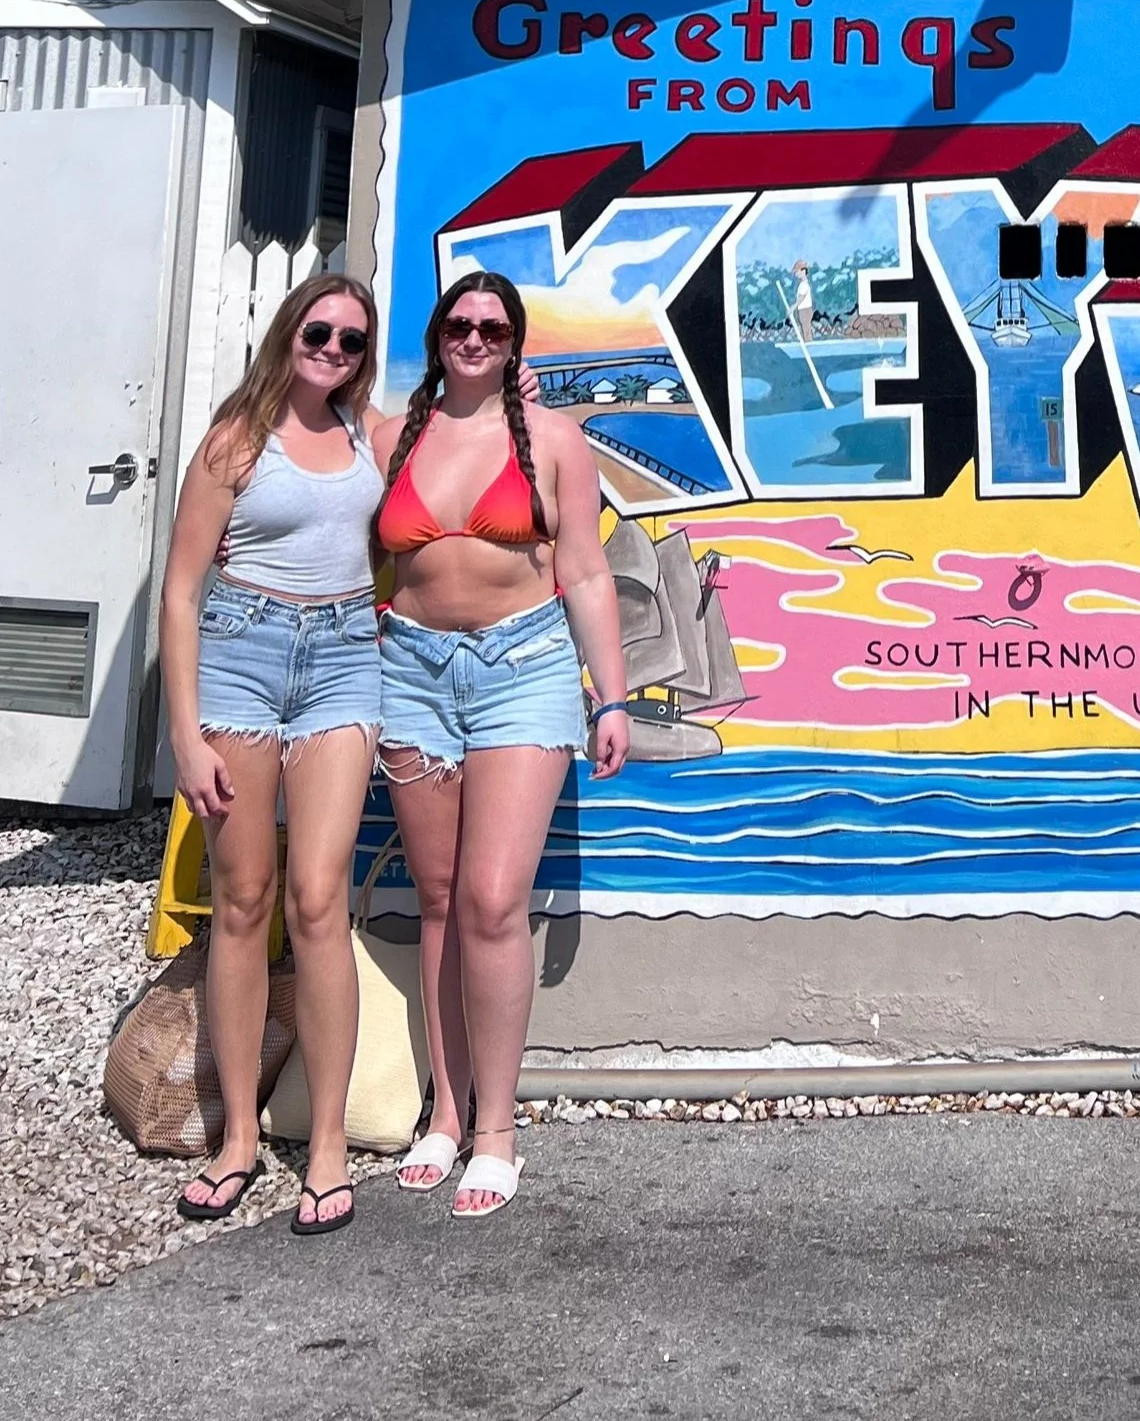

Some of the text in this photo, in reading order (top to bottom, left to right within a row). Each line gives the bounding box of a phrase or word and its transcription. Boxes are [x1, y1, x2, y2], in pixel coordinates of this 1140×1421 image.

[627, 78, 811, 113] FROM
[953, 690, 991, 720] IN
[1021, 689, 1101, 719] THE
